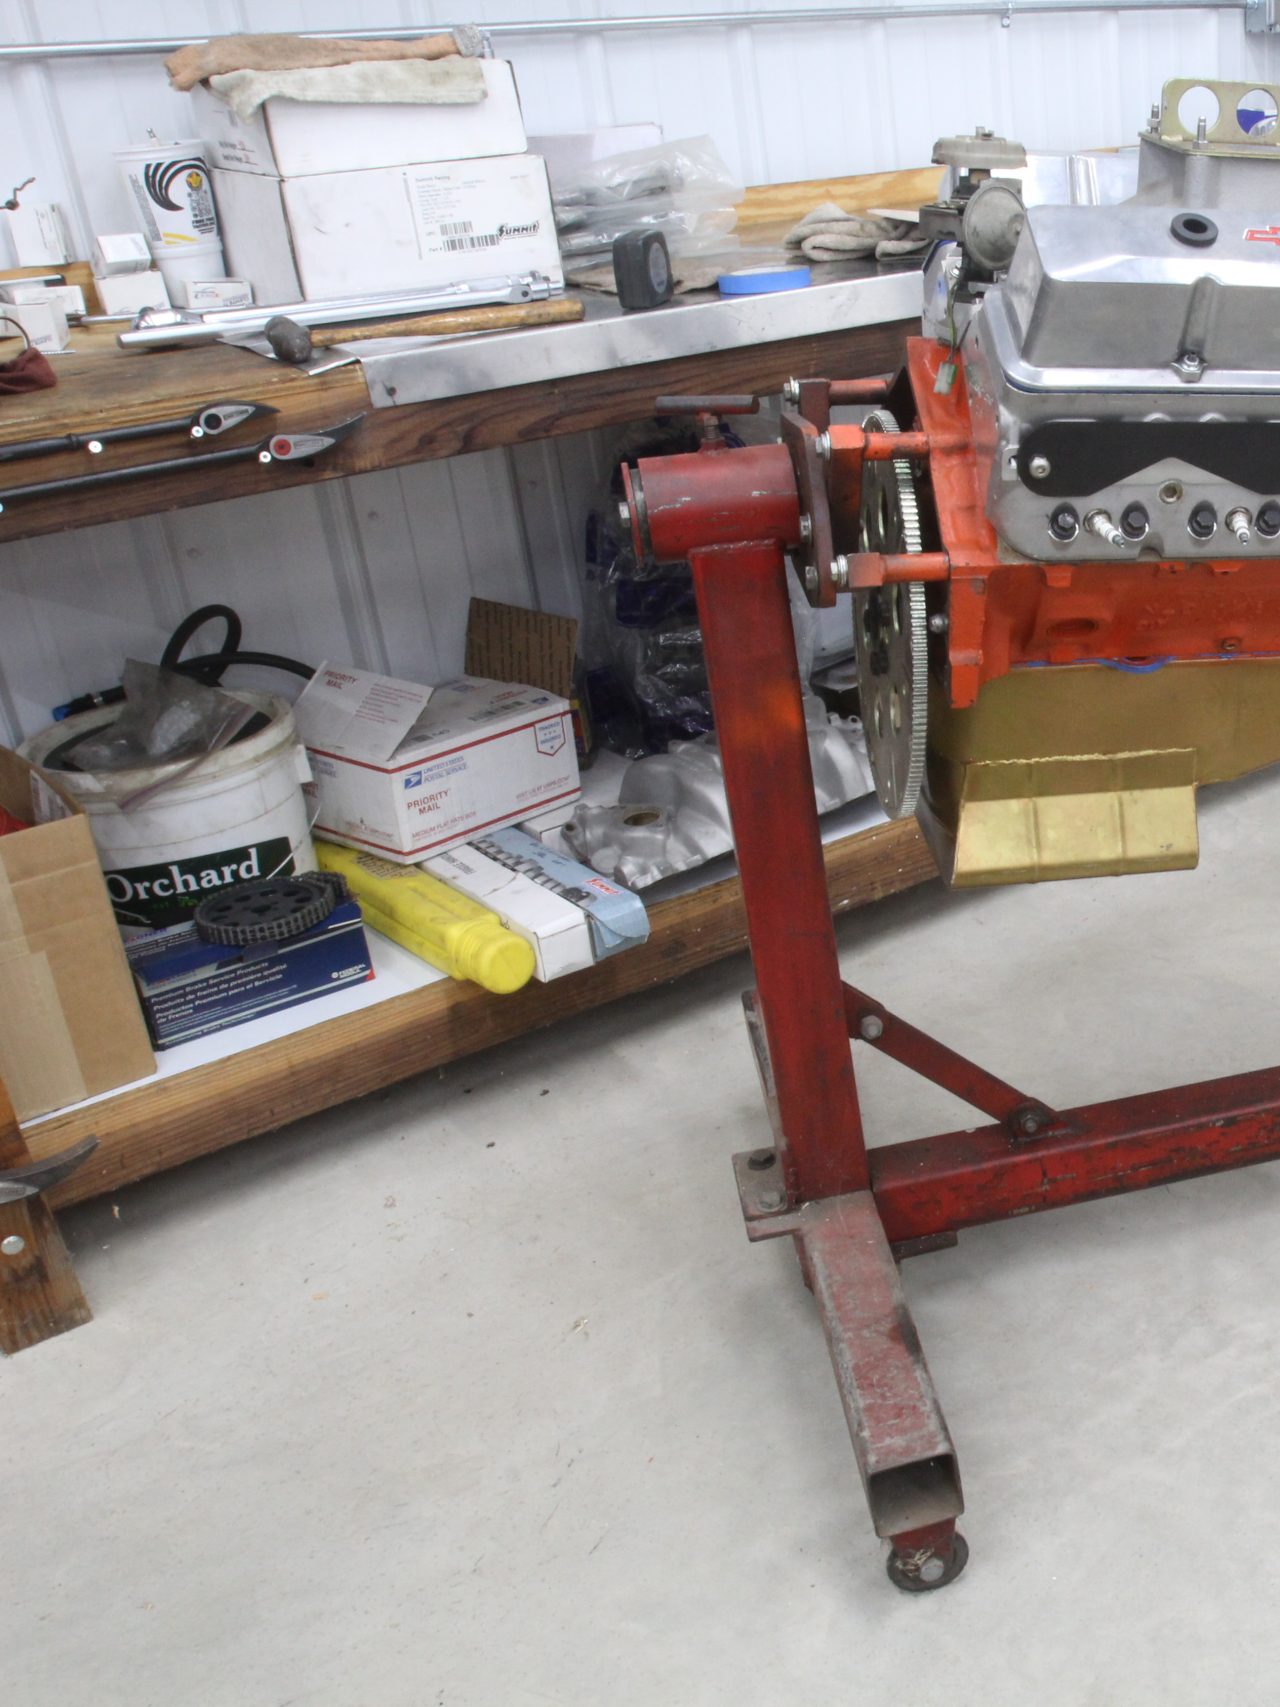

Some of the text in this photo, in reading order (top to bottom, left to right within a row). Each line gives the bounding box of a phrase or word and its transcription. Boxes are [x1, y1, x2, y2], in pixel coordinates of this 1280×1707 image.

[323, 670, 358, 684] PRIORITY
[325, 679, 342, 690] MAIL
[407, 789, 450, 810] PRIORITY
[418, 803, 441, 815] MAIL
[105, 847, 261, 903] Orchard
